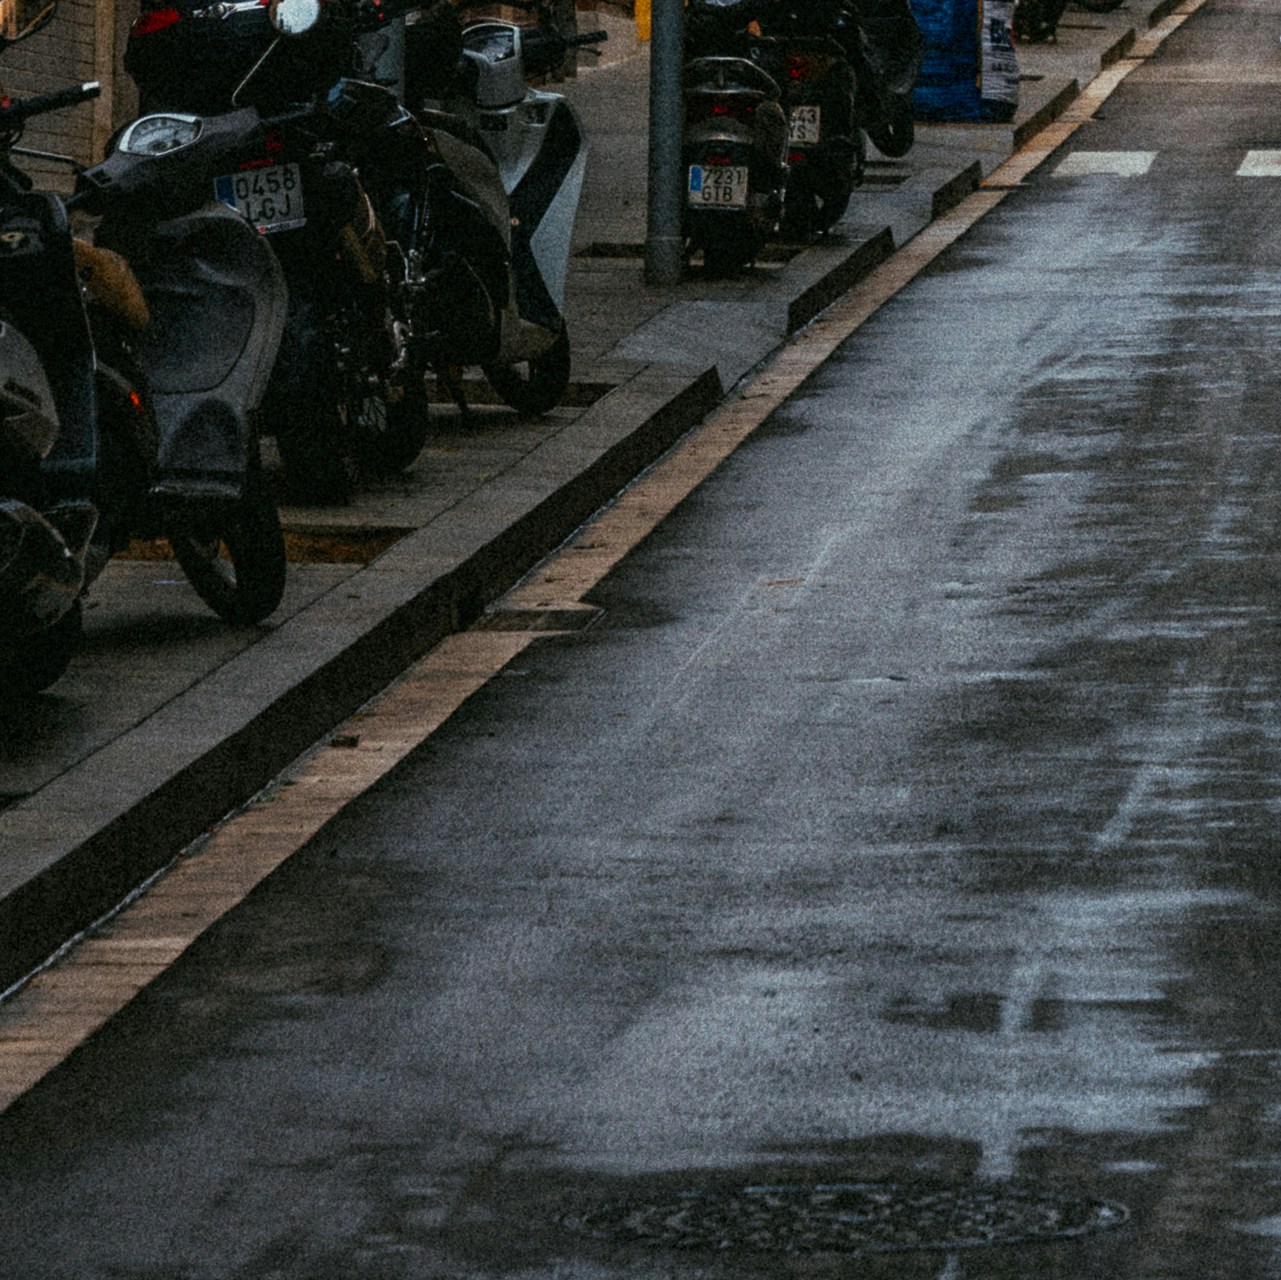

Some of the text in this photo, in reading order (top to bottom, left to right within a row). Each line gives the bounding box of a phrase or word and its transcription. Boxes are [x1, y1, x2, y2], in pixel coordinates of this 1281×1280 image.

[236, 167, 295, 199] 0458
[703, 168, 742, 185] 7231
[702, 186, 732, 202] GTB
[246, 194, 291, 222] LGJ
